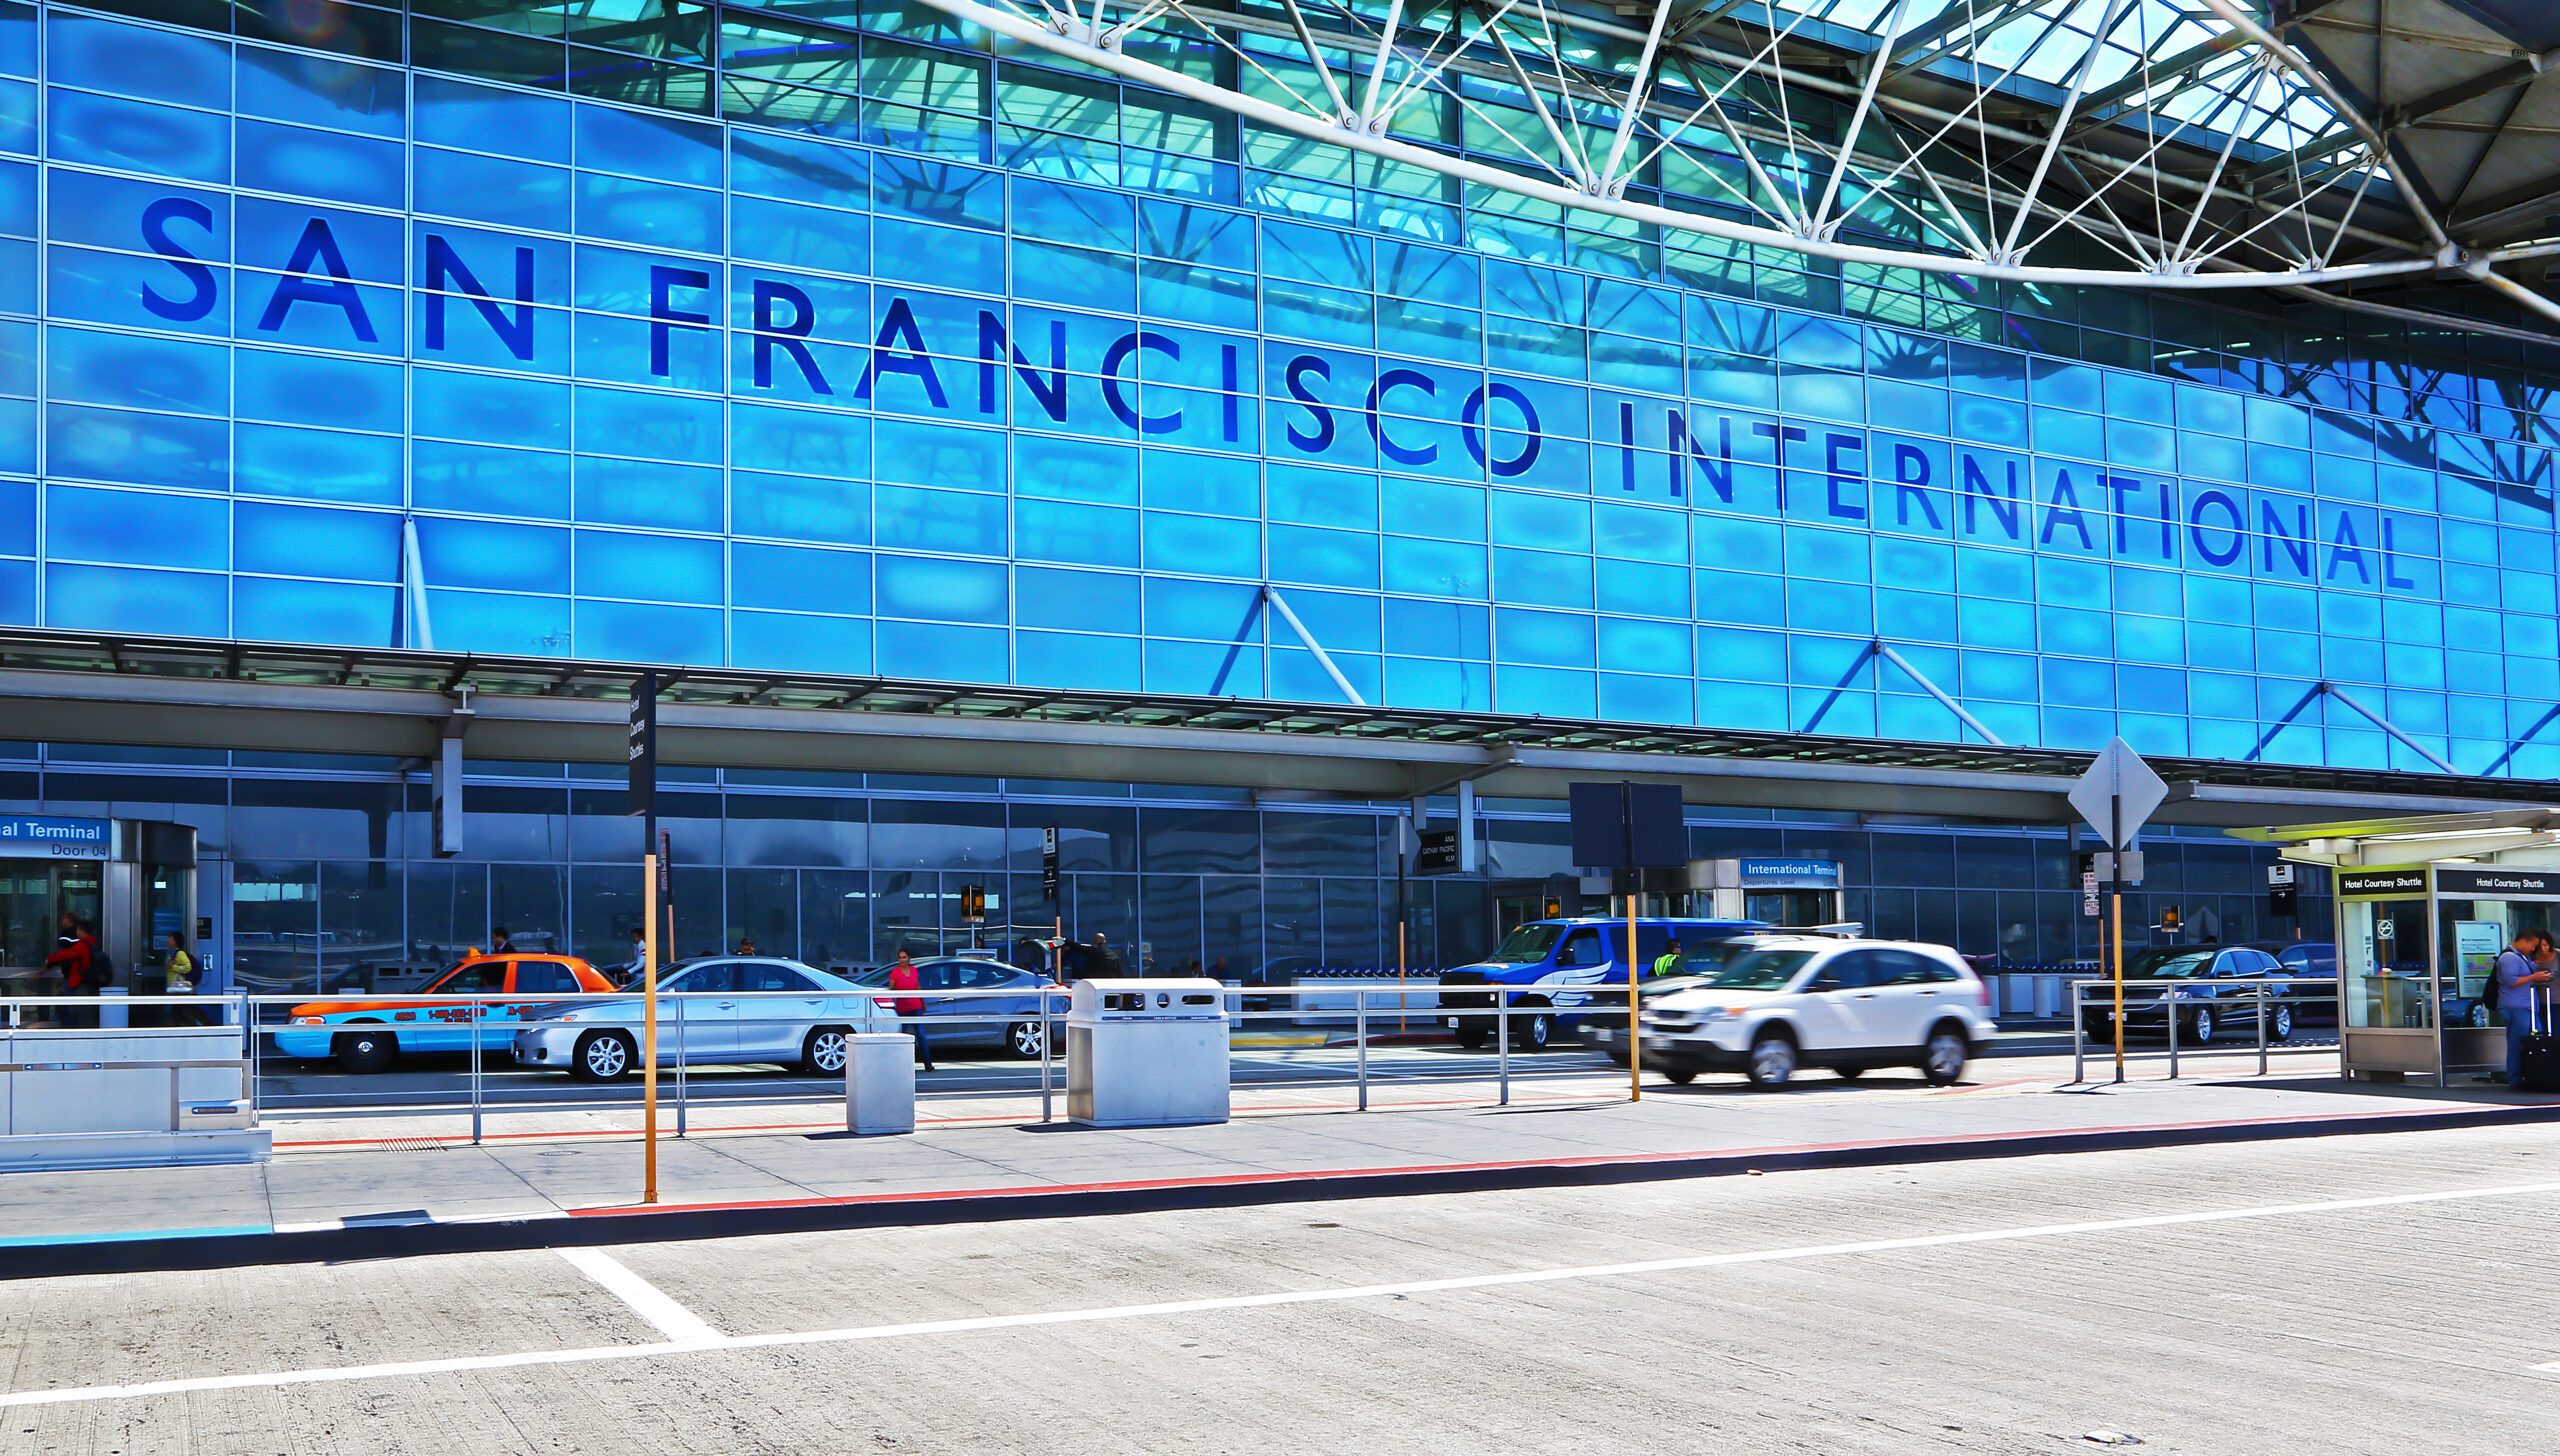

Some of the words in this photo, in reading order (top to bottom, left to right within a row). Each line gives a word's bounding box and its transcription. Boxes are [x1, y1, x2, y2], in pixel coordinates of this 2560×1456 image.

[141, 196, 534, 362] SAN
[649, 263, 1543, 478] FRANCISCO
[1620, 401, 2414, 590] INTERNATIONAL
[25, 822, 100, 840] Terminal
[52, 843, 87, 856] Door
[92, 846, 106, 857] 04
[1748, 863, 1811, 875] International
[1813, 864, 1837, 875] Terminal
[2344, 879, 2363, 889] Hotel
[2364, 878, 2395, 888] Courtesy
[2396, 877, 2422, 887] Shuttle
[2476, 878, 2493, 887] Hotel
[2494, 878, 2521, 889] Courtesy
[2522, 879, 2545, 888] Shuttle
